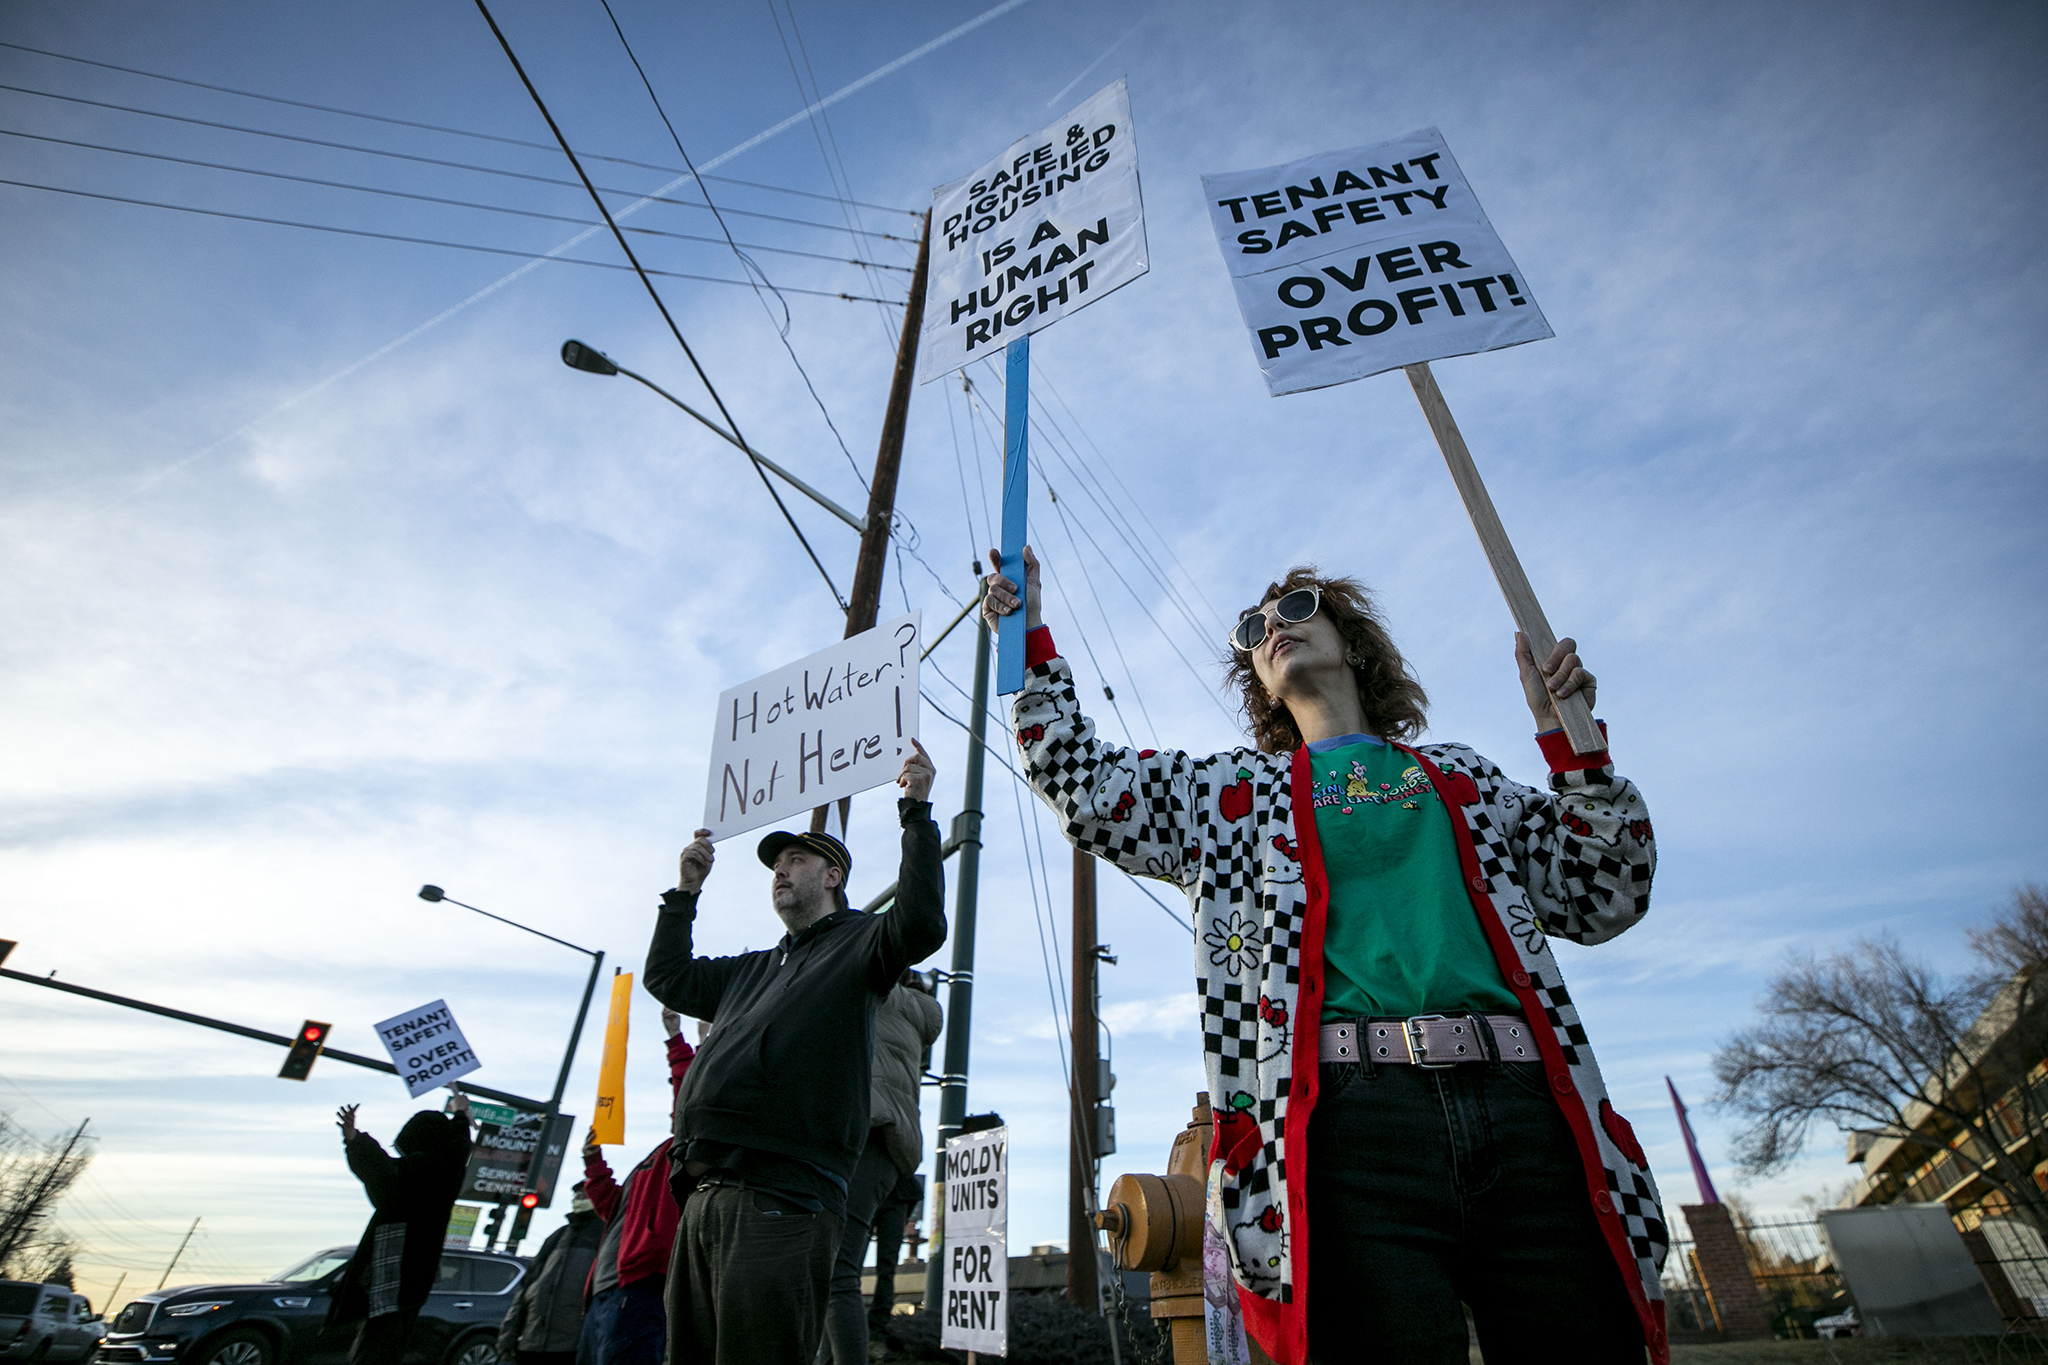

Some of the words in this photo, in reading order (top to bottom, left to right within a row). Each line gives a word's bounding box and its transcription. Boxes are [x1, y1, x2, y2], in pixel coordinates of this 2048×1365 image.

[943, 124, 1115, 236] DIGNIFIED
[969, 142, 1053, 200] SAFE
[1066, 124, 1085, 146] &
[949, 148, 1110, 251] HOUSING
[1218, 152, 1440, 223] TENANT
[1237, 184, 1449, 254] SAFETY
[982, 238, 1016, 276] IS
[1028, 220, 1061, 250] A
[950, 217, 1109, 325] HUMAN
[1278, 240, 1472, 308] OVER
[966, 260, 1094, 351] RIGHT
[1257, 273, 1527, 359] PROFIT!
[732, 686, 794, 741] Hot
[805, 623, 916, 710] Water?
[720, 758, 785, 822] Not
[800, 686, 902, 794] Here!
[1312, 784, 1346, 799] KIND
[1313, 794, 1341, 809] ARE
[382, 1008, 448, 1040] TENANT
[391, 1020, 452, 1051] SAFETY
[406, 1050, 475, 1087] PROFIT!
[408, 1041, 459, 1068] OVER
[481, 1135, 561, 1156] MOUNTN
[499, 1126, 541, 1140] ROCK
[476, 1166, 528, 1183] SERVIC
[947, 1142, 1004, 1180] MOLDY
[951, 1179, 998, 1212] UNITS
[953, 1246, 992, 1283] FOR
[948, 1290, 1000, 1330] RENT
